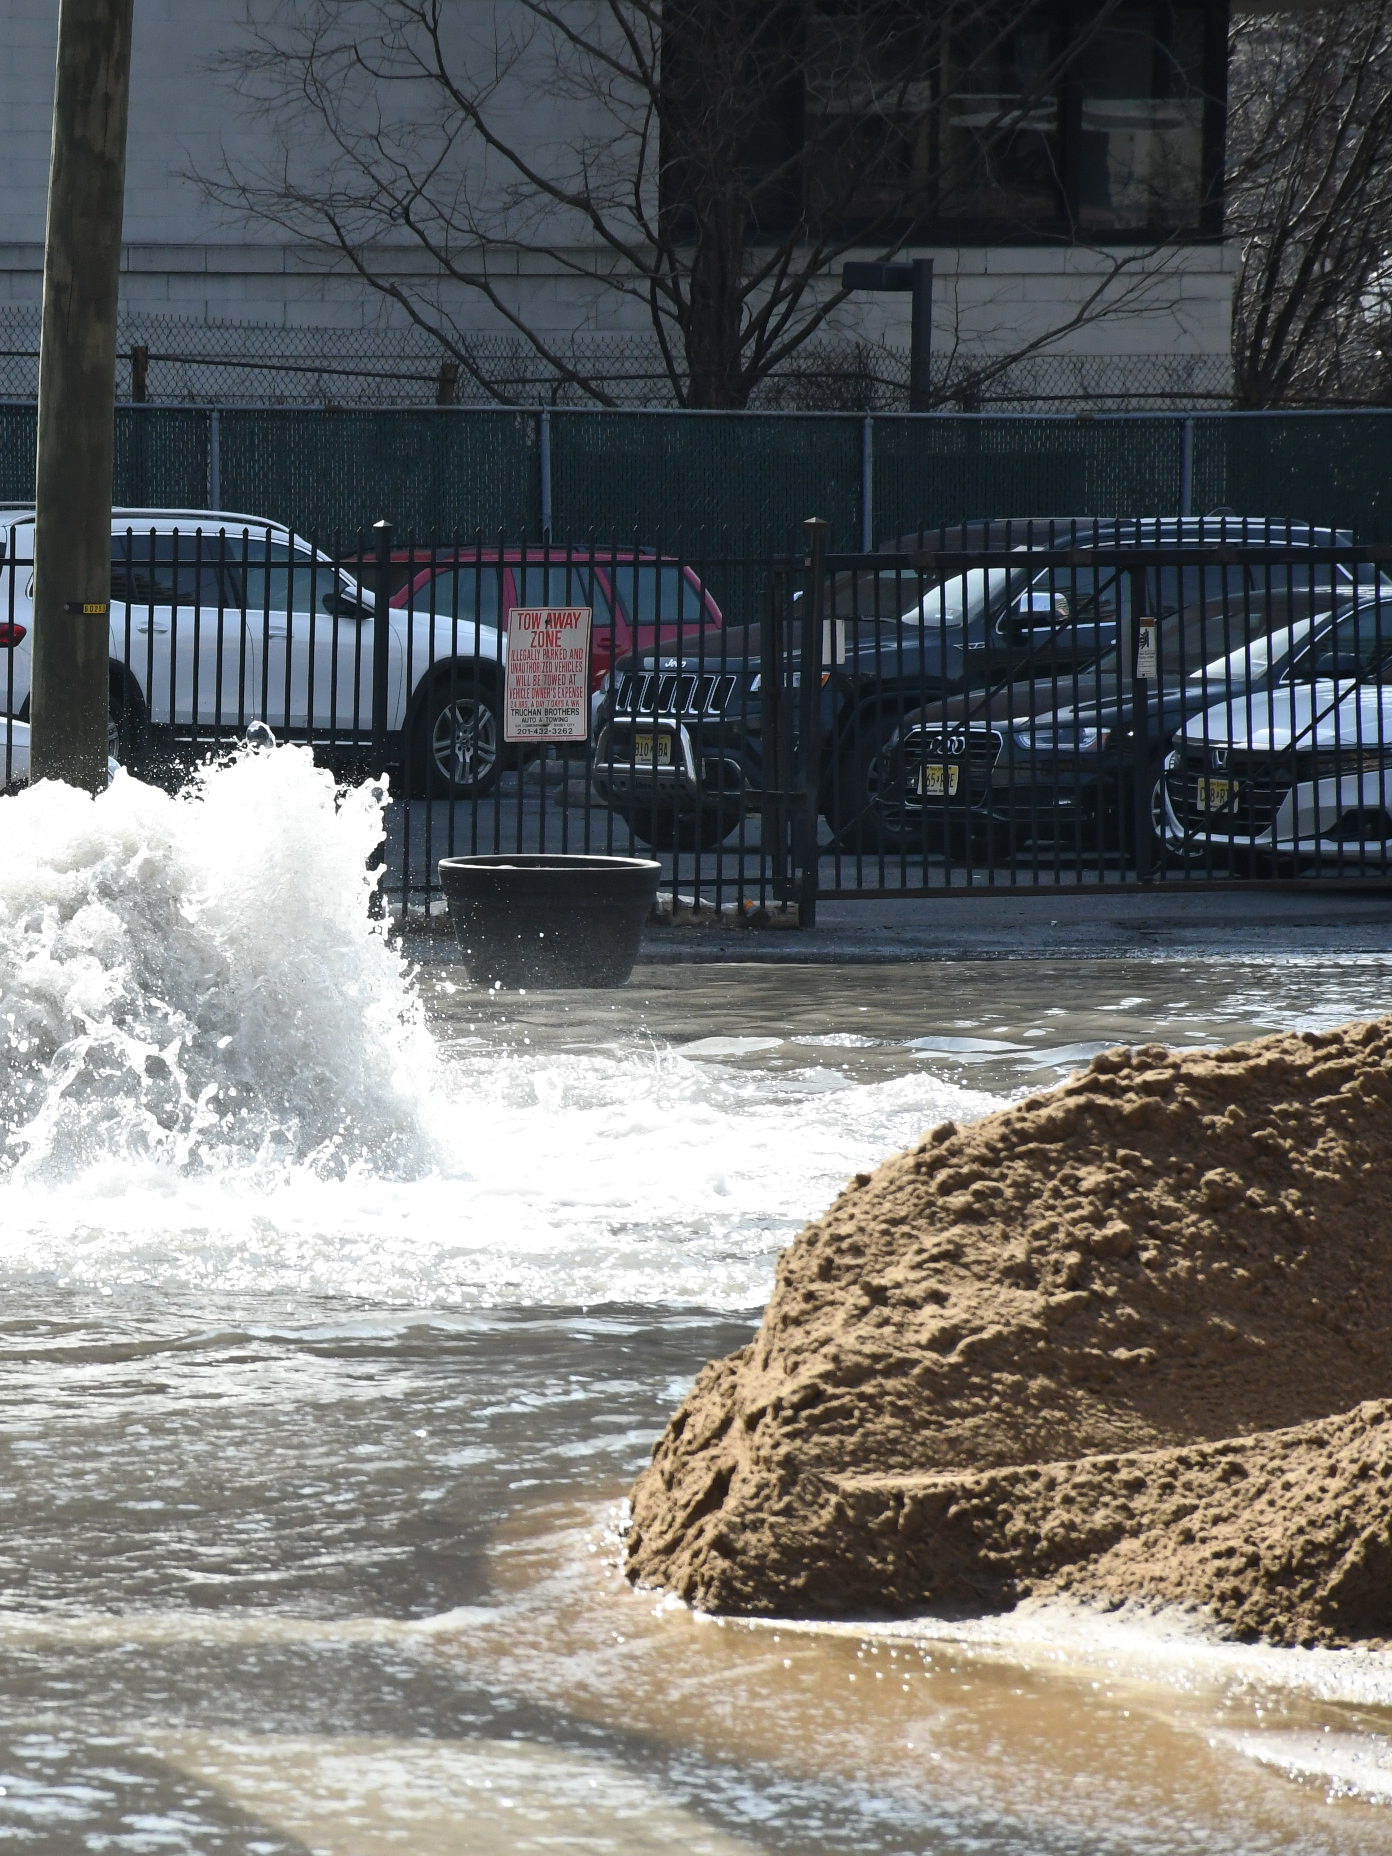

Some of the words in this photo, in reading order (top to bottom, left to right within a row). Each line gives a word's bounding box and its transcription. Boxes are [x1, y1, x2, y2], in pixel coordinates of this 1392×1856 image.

[518, 612, 542, 630] TOW
[545, 612, 582, 630] AWAY
[530, 630, 562, 648] ZONE
[511, 648, 541, 661] ILLEGALLY
[543, 648, 567, 661] PARKED
[569, 648, 584, 661] AND
[510, 661, 553, 674] UNAUTHORIZED
[555, 661, 583, 673] VEHICLES
[515, 674, 531, 687] WILL
[533, 674, 541, 687] BE
[543, 674, 567, 686] TOWED
[568, 674, 577, 686] AT
[509, 687, 530, 700] VEHICLE
[531, 687, 556, 699] OWNER'S
[558, 686, 583, 699] EXPENSE
[535, 700, 545, 708] DAY
[510, 708, 542, 717] TRUCHAN
[545, 708, 580, 716] BROTHERS
